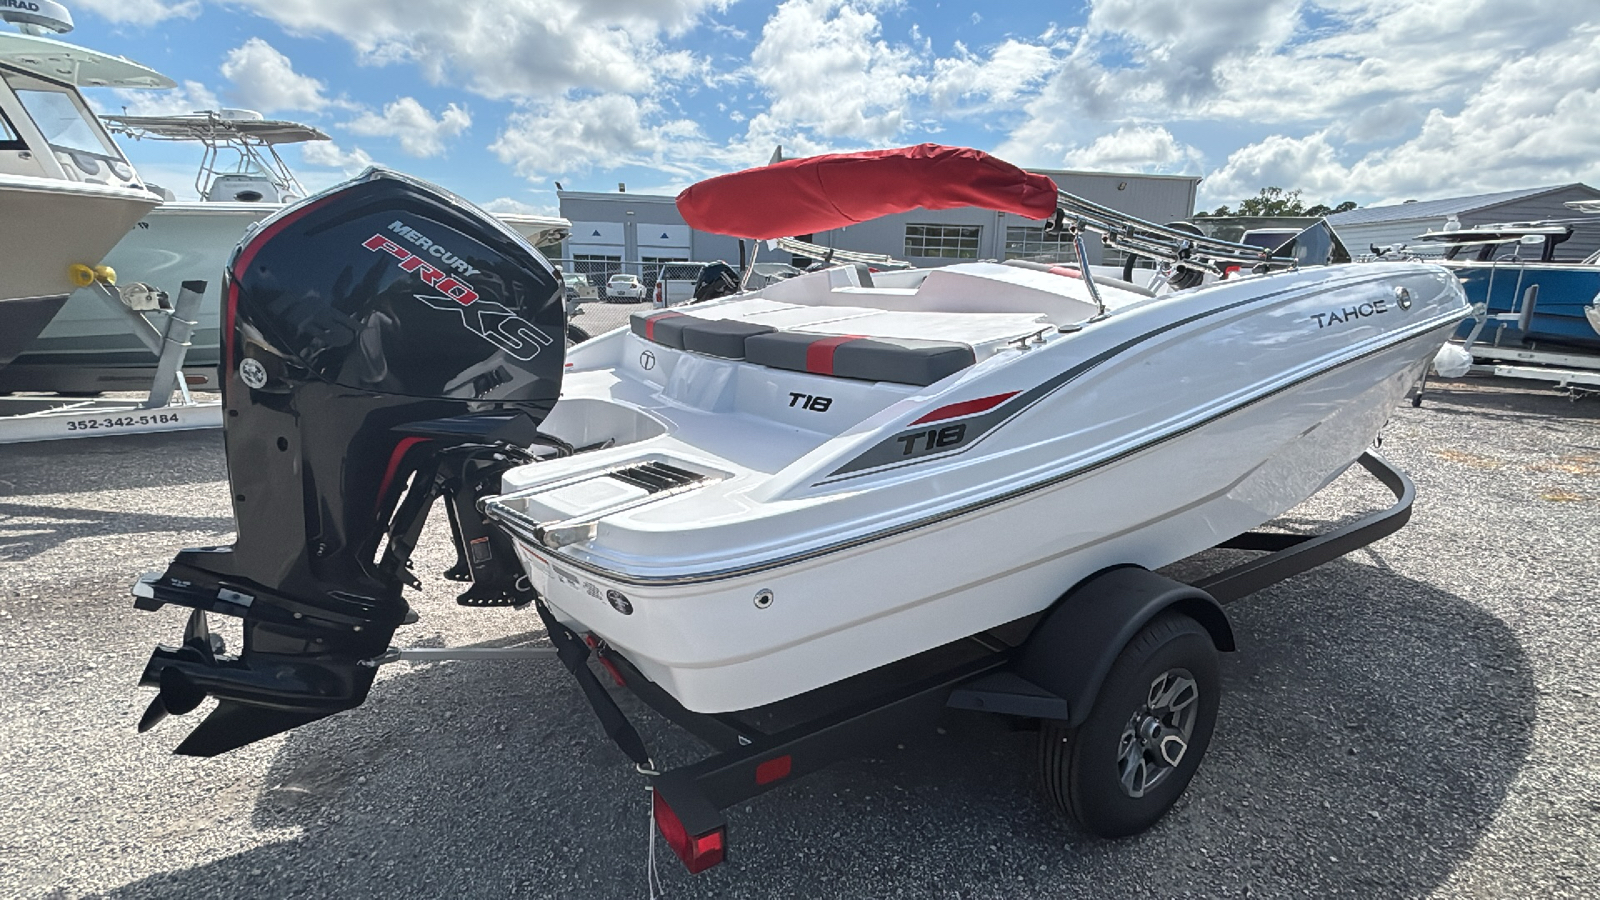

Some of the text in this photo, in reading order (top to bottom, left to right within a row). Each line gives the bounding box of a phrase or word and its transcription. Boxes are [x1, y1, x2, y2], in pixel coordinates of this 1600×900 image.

[387, 220, 481, 277] MERCURY
[362, 233, 553, 361] PRO XS
[1310, 300, 1388, 328] TAHOE
[789, 392, 833, 413] T18
[67, 413, 179, 431] 352-342-5184
[897, 423, 967, 456] T18
